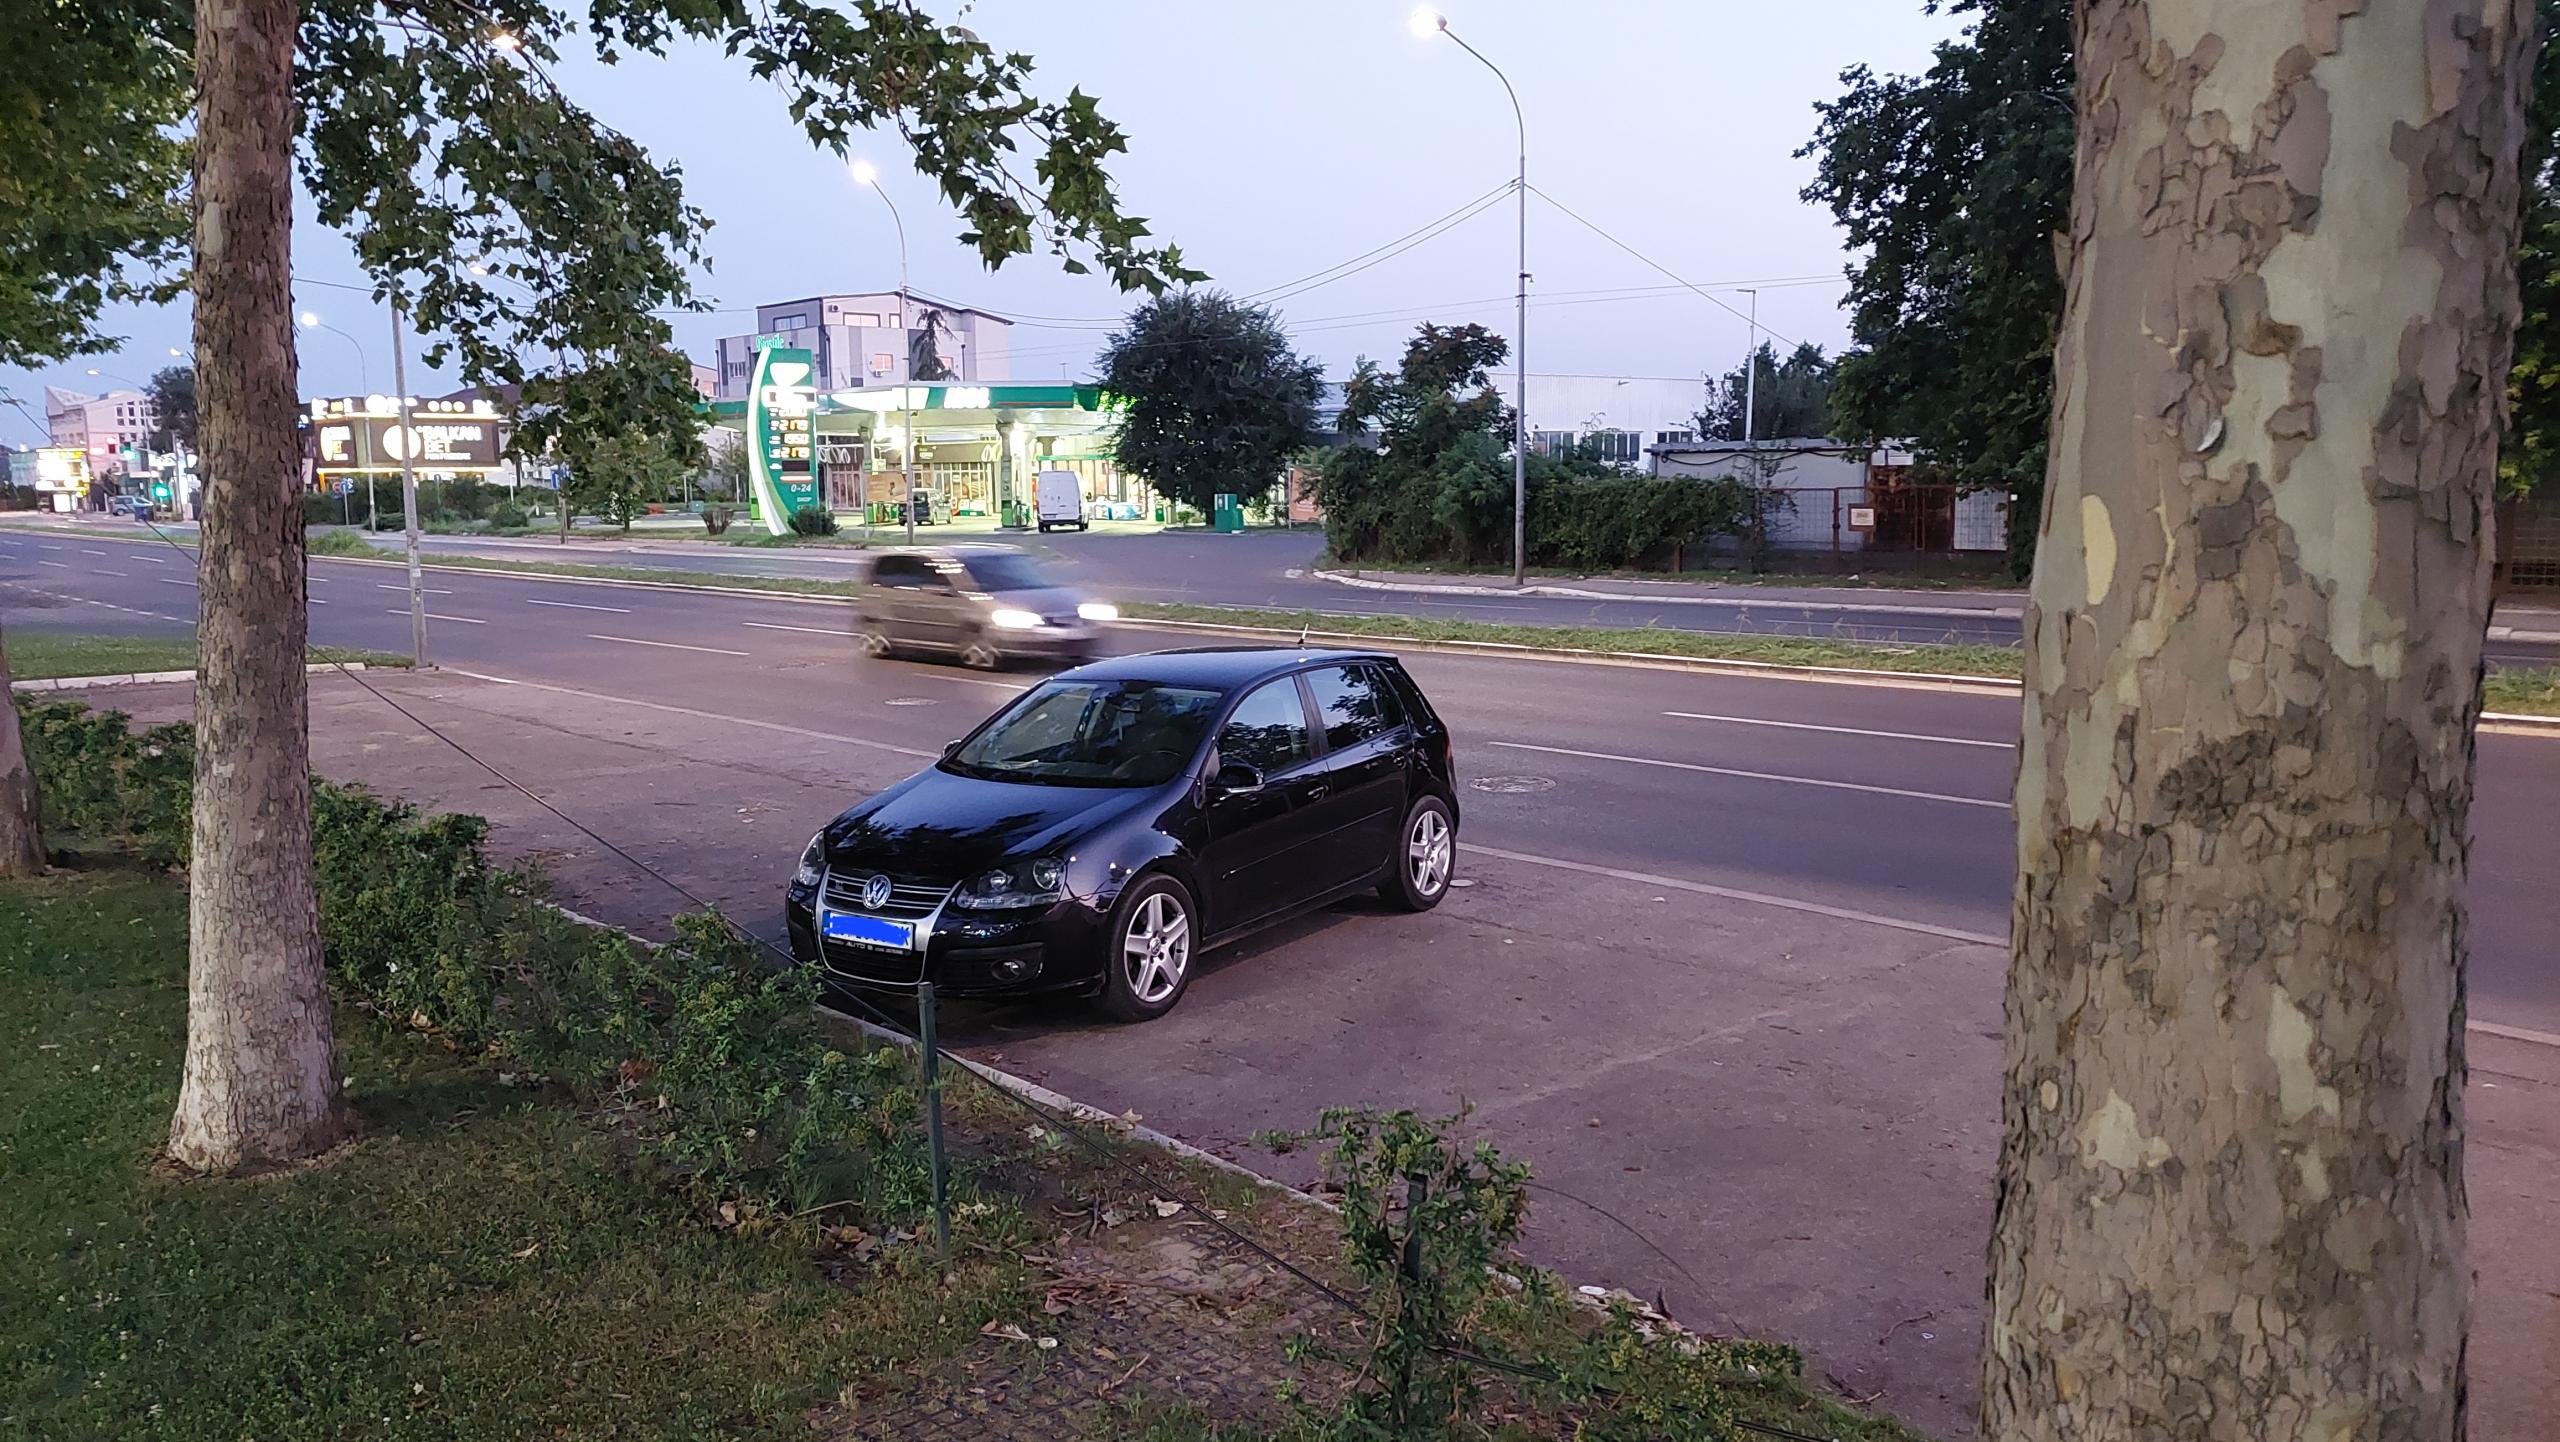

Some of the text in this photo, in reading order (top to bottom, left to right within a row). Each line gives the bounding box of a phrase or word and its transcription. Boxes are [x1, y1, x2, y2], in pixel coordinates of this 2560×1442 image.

[423, 426, 483, 440] BALKAN
[424, 440, 453, 453] BET
[791, 484, 812, 493] 0-24
